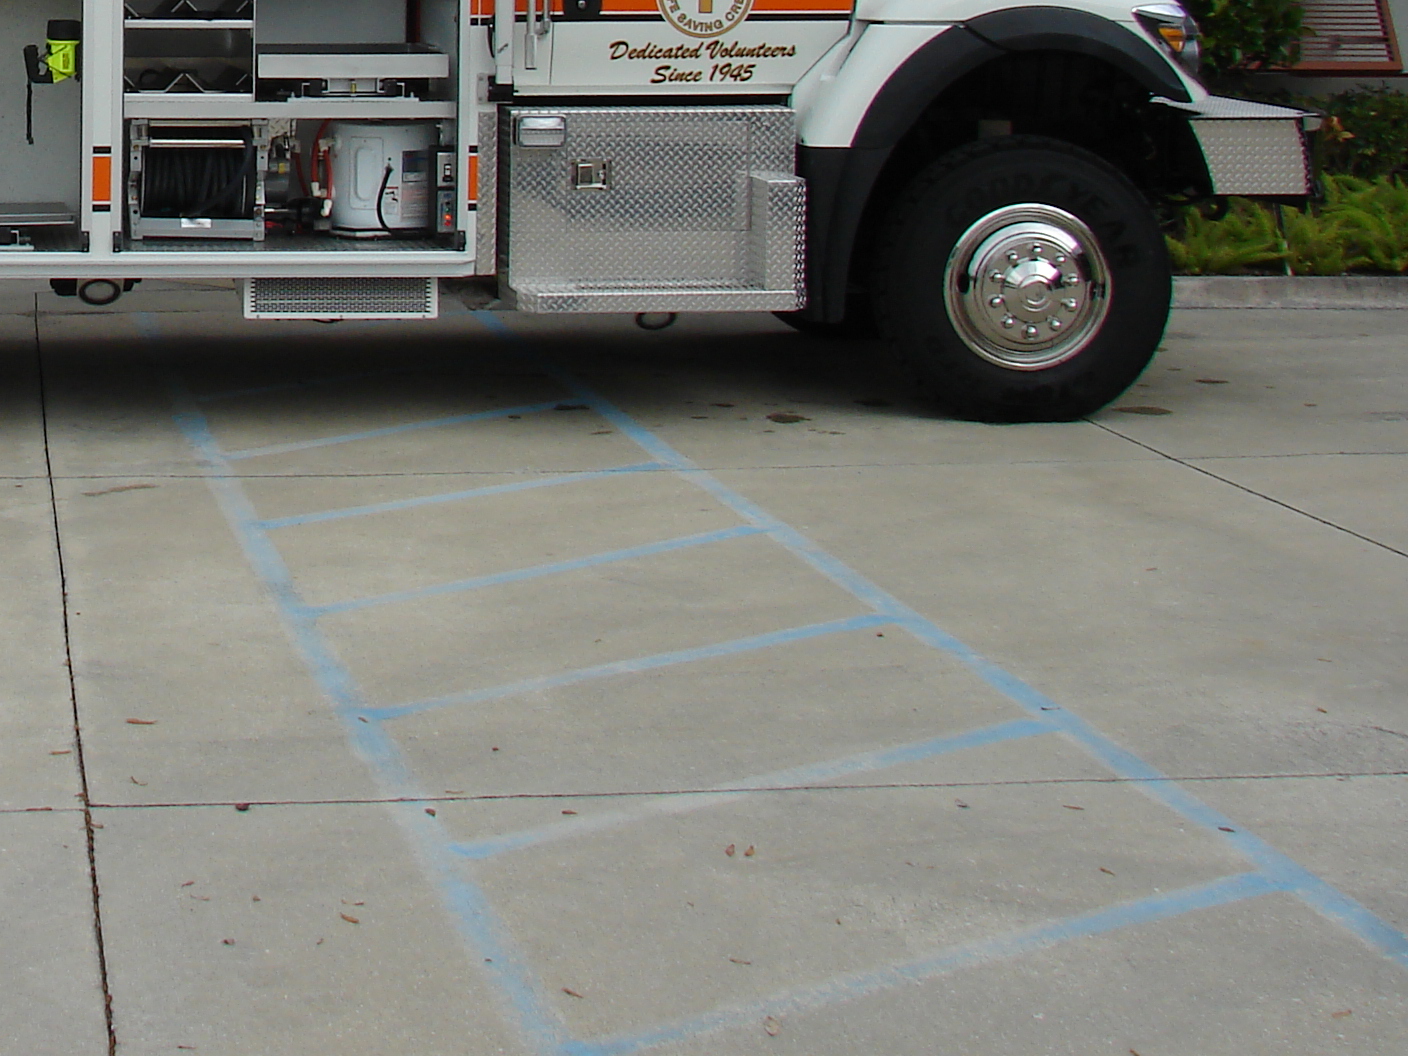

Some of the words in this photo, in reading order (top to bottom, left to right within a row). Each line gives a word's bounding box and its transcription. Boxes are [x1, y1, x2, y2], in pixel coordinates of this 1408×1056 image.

[676, 13, 724, 32] SAVING
[609, 40, 704, 60] Dedicated
[705, 39, 797, 59] Volunteers
[650, 65, 702, 84] Since
[709, 63, 756, 82] 1945
